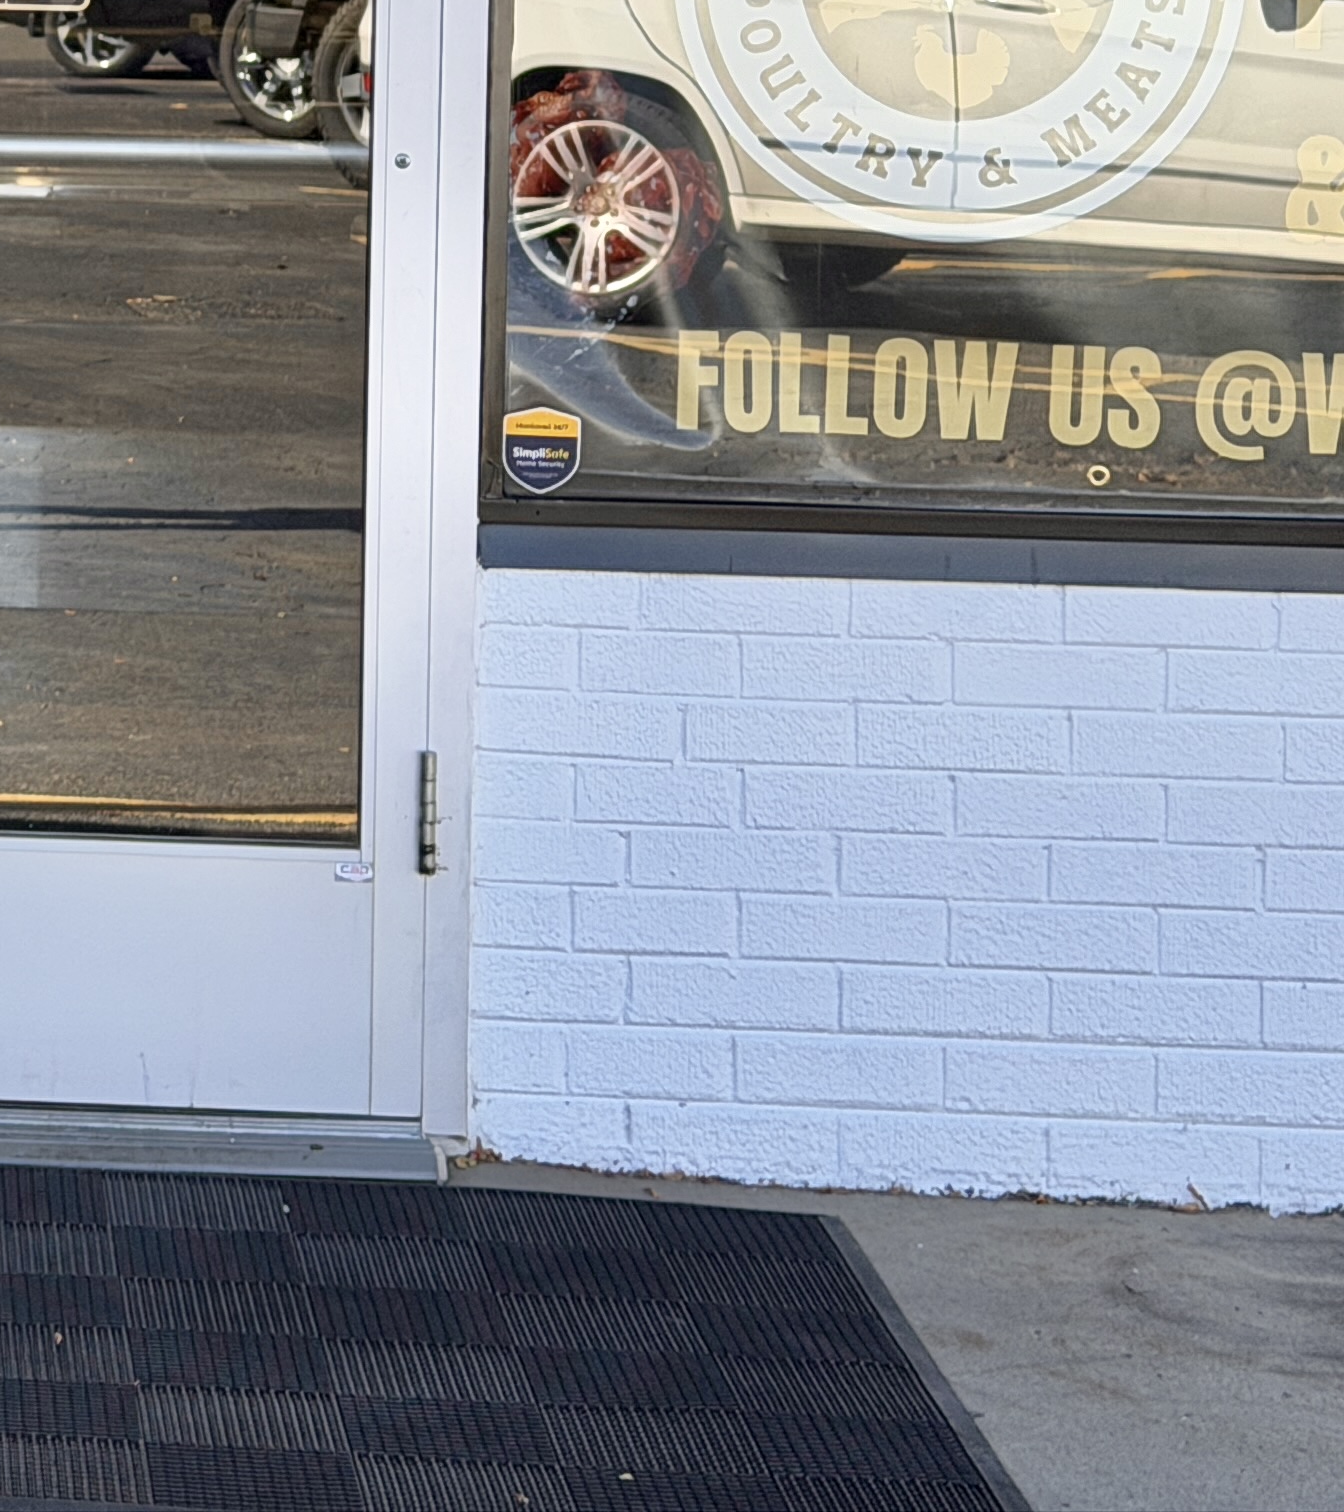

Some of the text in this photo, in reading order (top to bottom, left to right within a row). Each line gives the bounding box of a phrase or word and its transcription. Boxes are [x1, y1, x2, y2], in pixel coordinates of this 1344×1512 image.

[977, 147, 1018, 188] &
[675, 329, 1020, 441] FOLLOW
[1048, 343, 1163, 450] US
[512, 446, 570, 460] SimpliSafe
